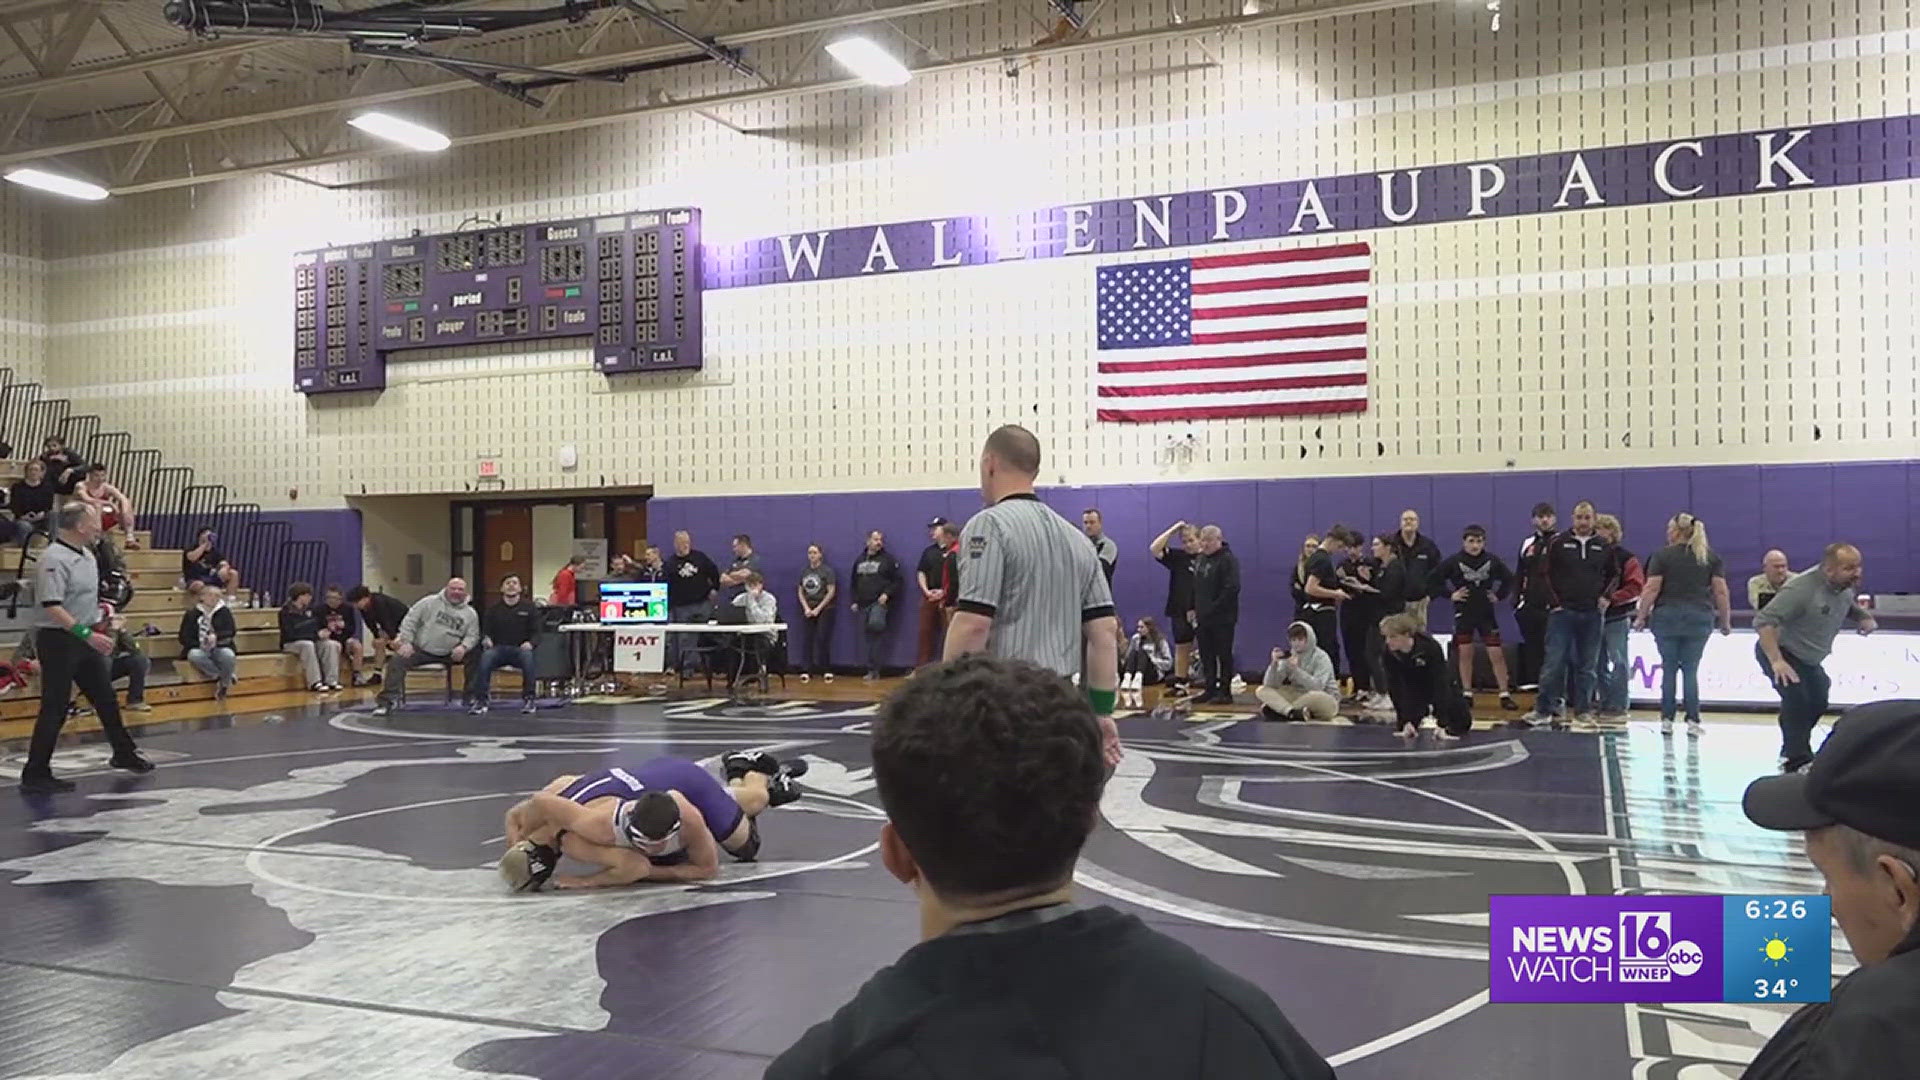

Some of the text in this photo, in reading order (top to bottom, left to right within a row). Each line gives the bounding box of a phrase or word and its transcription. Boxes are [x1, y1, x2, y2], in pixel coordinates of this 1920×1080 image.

[453, 292, 482, 307] period
[618, 635, 659, 646] MAT
[633, 652, 641, 661] 1
